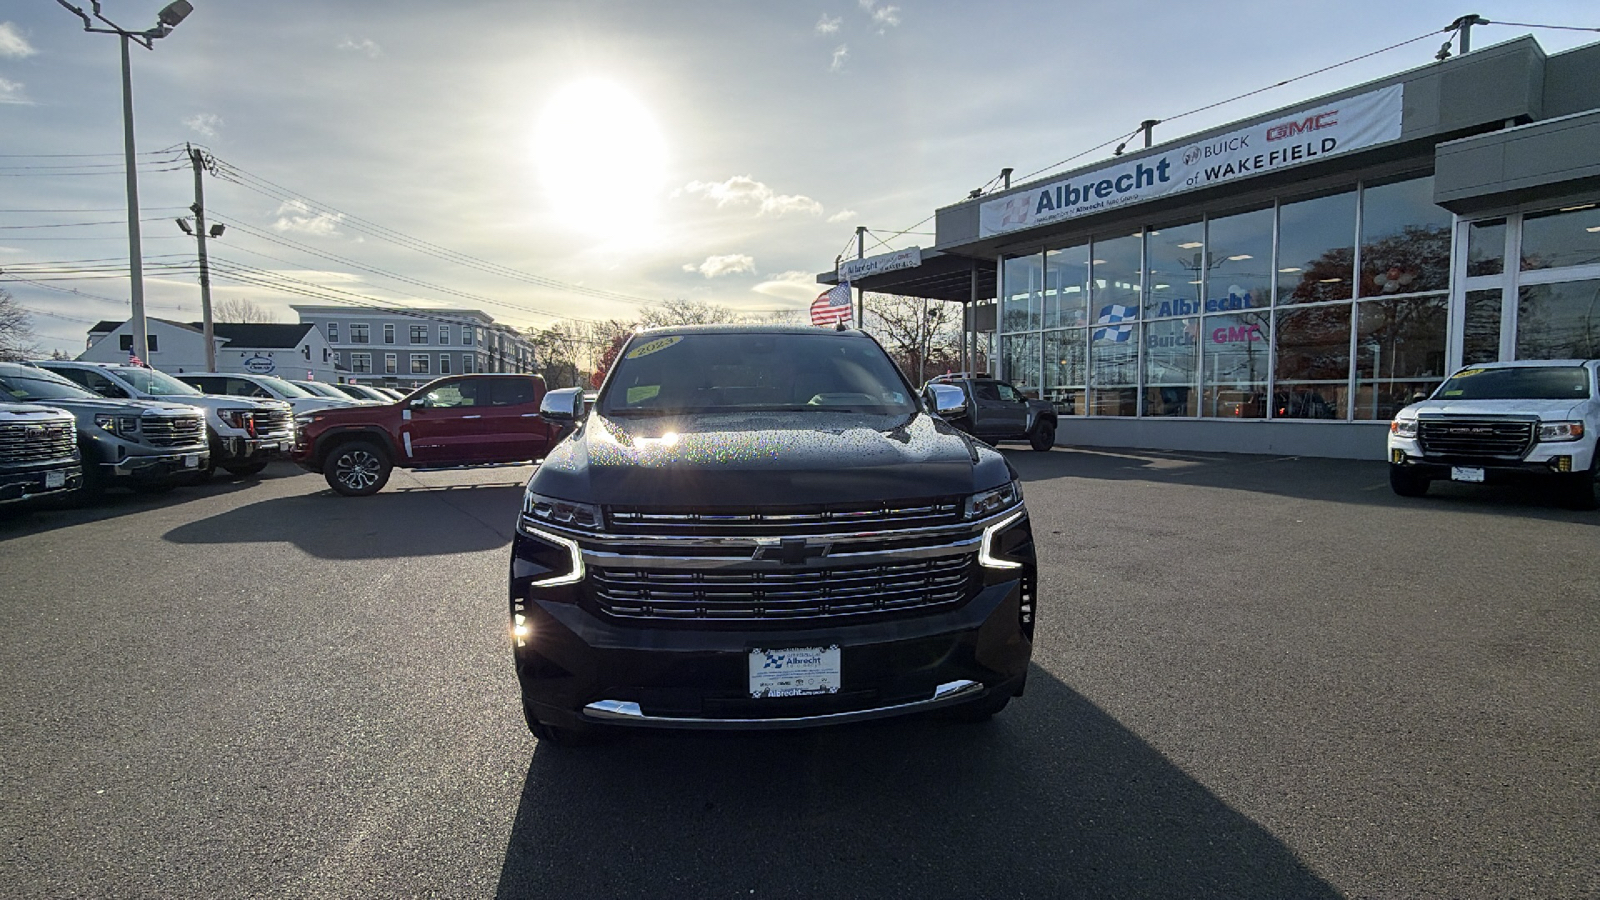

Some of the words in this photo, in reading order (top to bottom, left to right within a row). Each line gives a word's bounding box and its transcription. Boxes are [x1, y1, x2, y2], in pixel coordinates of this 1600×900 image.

[1204, 135, 1249, 158] BUICK
[1266, 110, 1339, 142] GMC
[1186, 172, 1200, 186] of
[1204, 137, 1337, 181] WAKEFIELD
[1035, 157, 1171, 215] Albrecht
[1076, 201, 1105, 213] Albrecht
[1158, 293, 1253, 317] Albrecht
[637, 337, 674, 355] 2023
[1149, 332, 1196, 348] Buick
[1212, 324, 1261, 344] GMC
[786, 656, 821, 665] Albrecht
[768, 688, 802, 698] Albrecht
